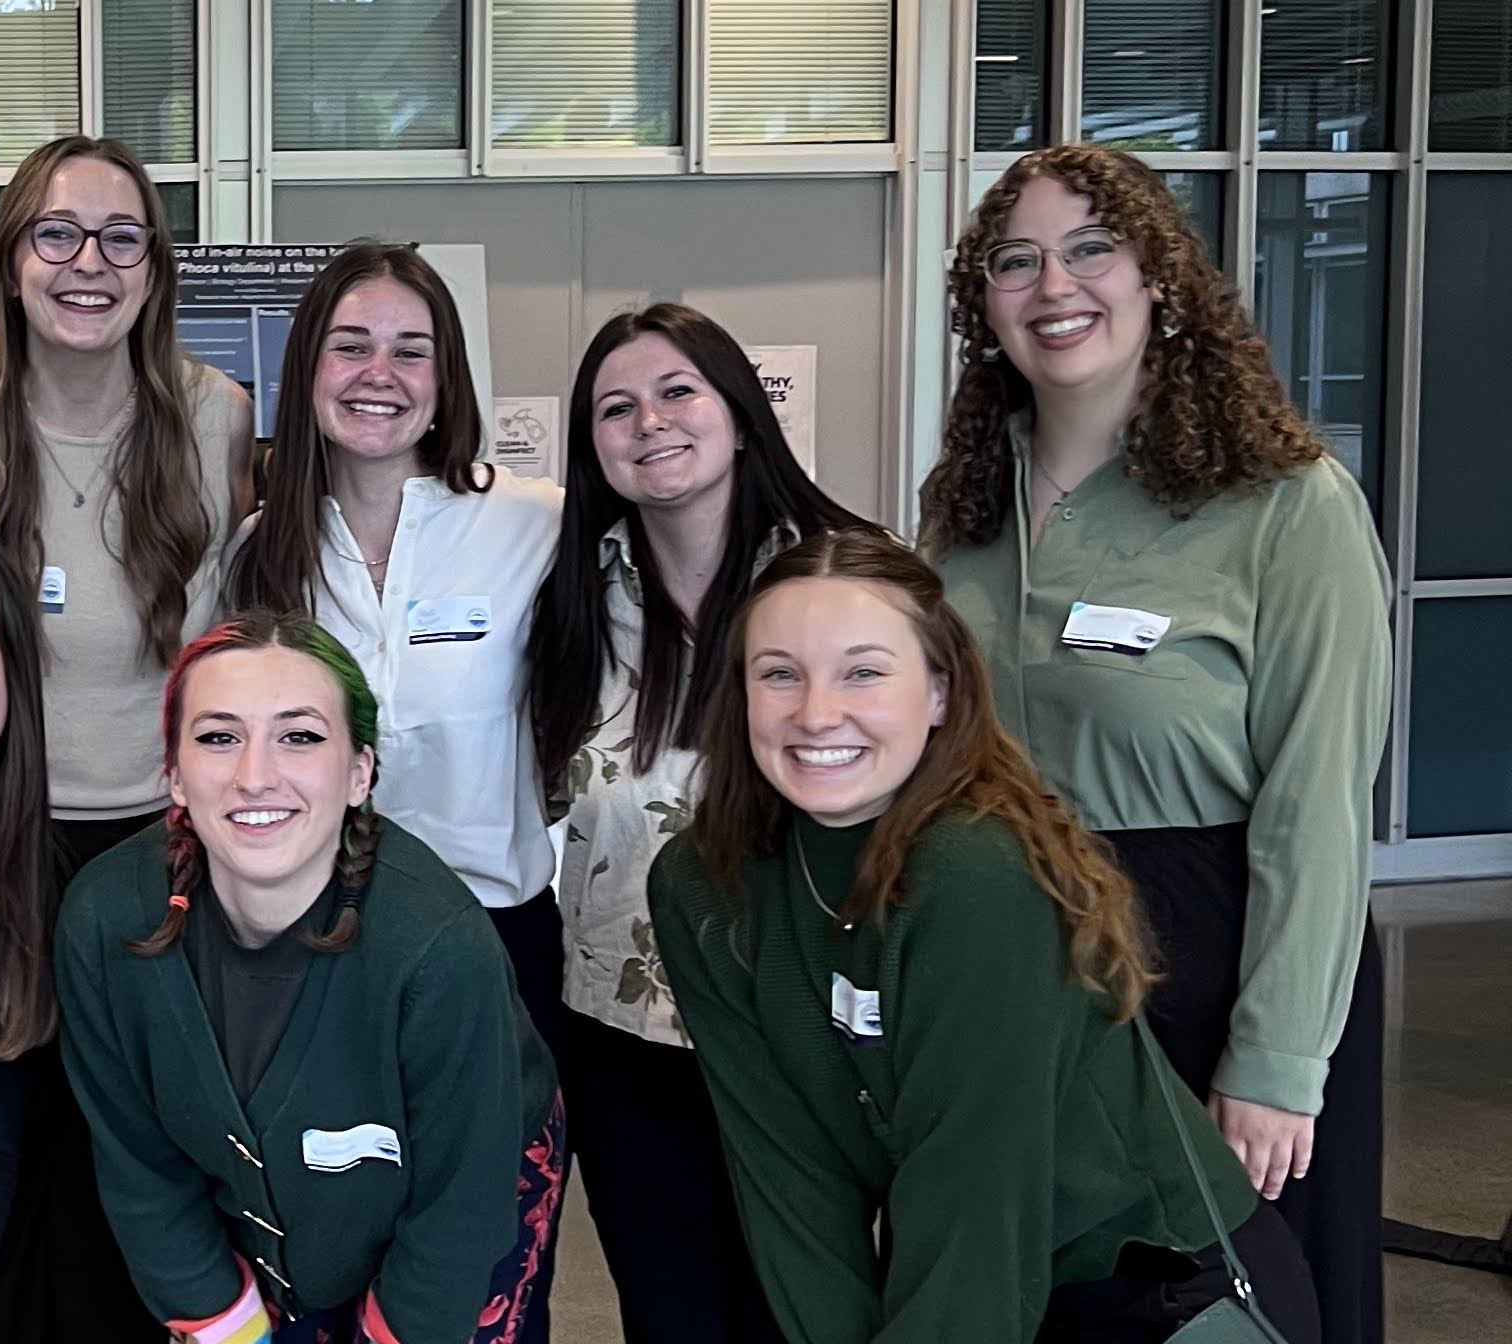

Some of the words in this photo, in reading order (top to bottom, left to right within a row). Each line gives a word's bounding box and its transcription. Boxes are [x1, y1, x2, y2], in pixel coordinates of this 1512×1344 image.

[245, 247, 283, 258] noise
[284, 248, 303, 257] on
[305, 247, 327, 257] the
[277, 263, 292, 273] at
[293, 262, 315, 273] the
